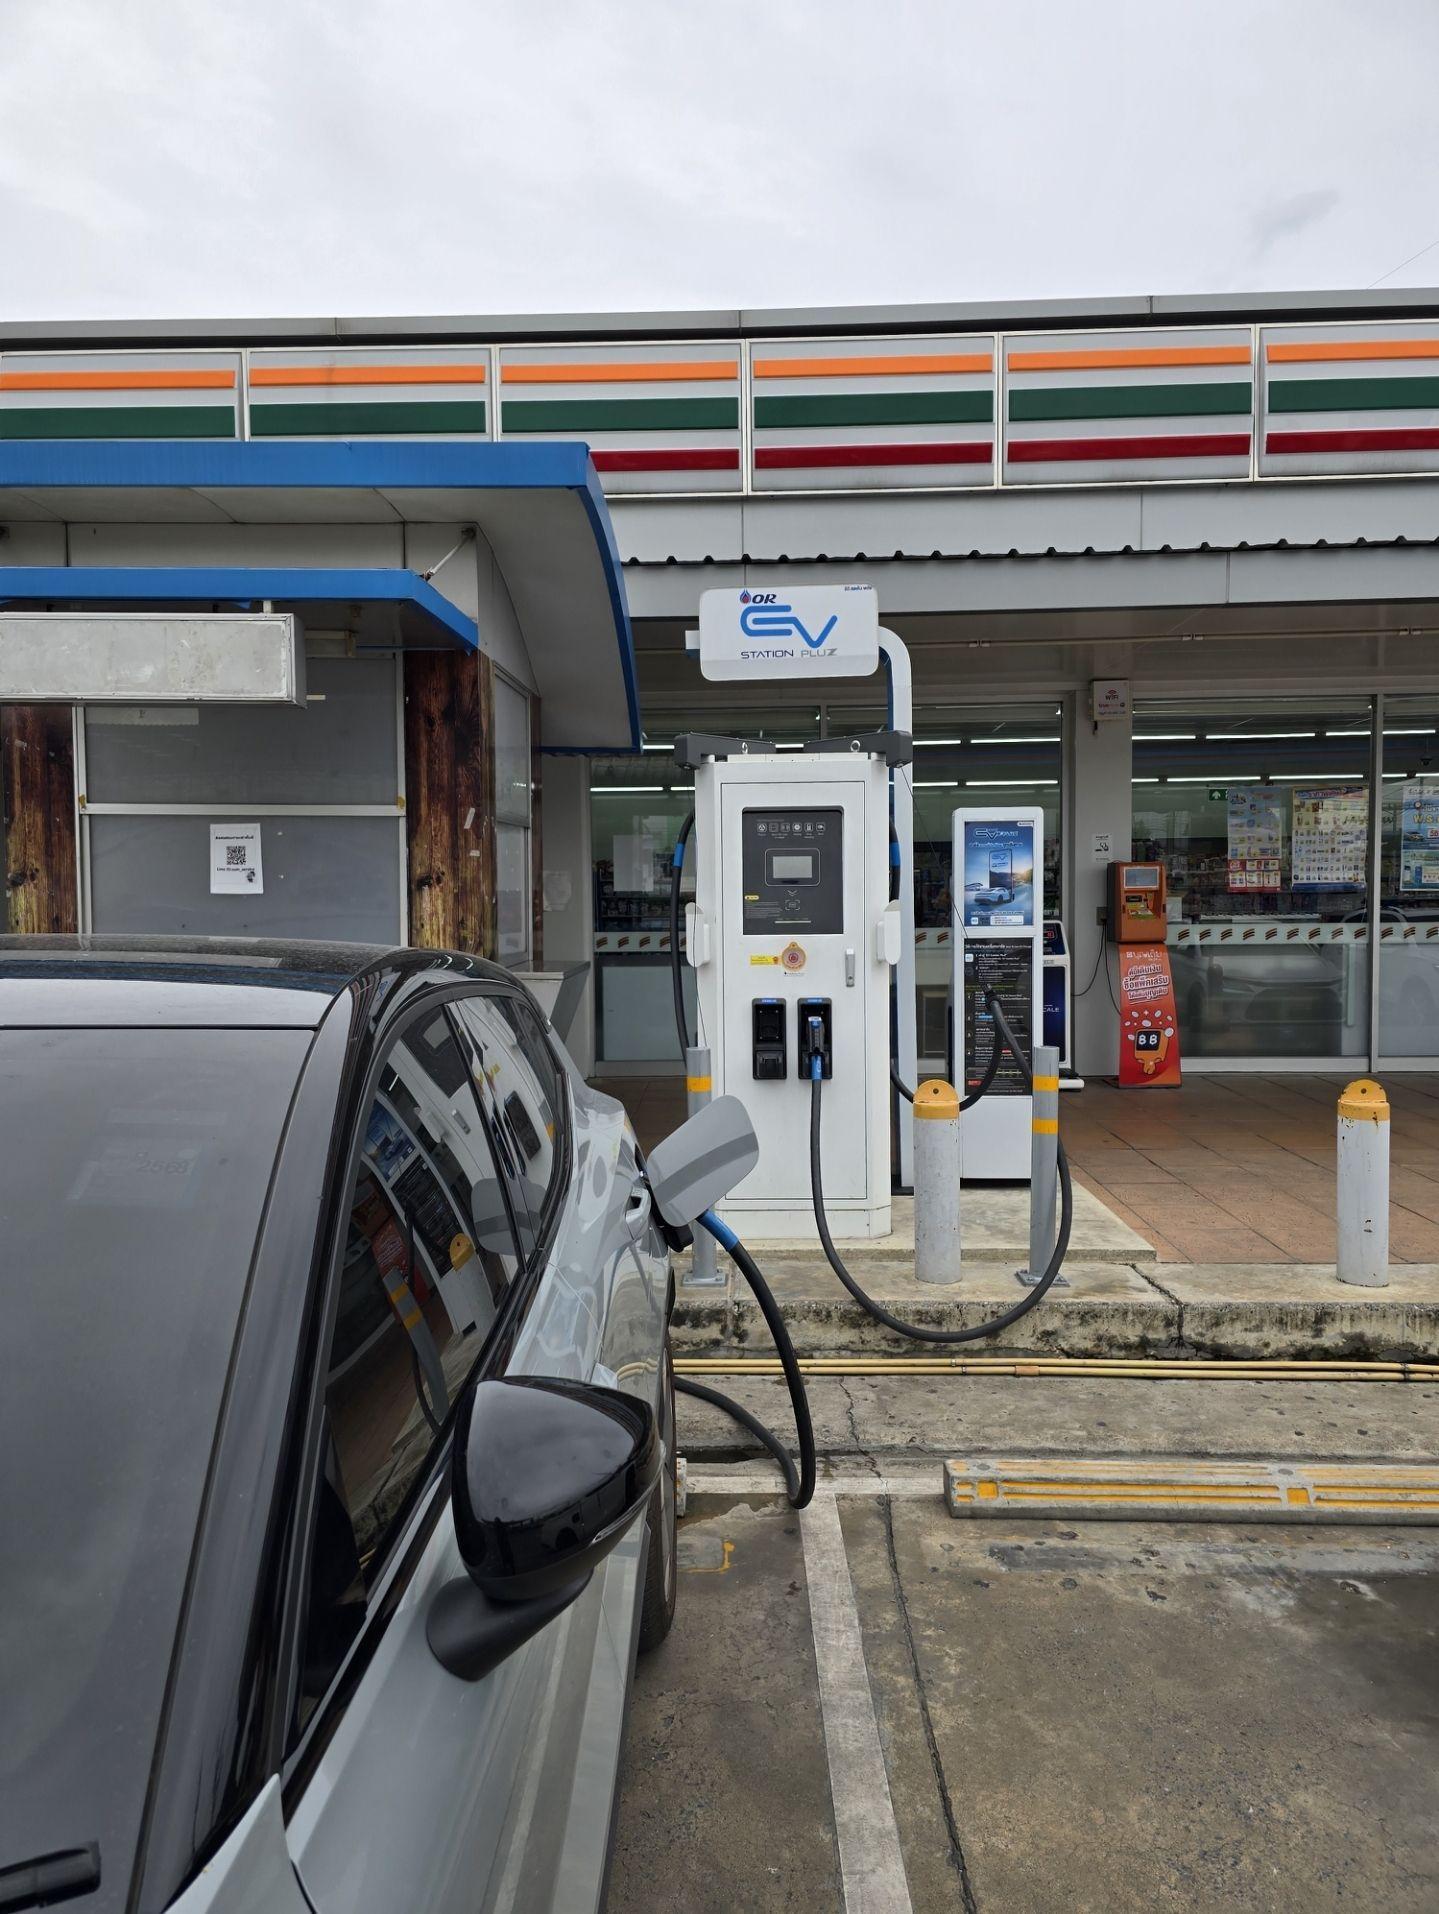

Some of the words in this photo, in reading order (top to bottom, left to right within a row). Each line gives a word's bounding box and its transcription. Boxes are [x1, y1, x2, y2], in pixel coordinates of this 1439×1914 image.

[752, 593, 777, 604] OR
[740, 605, 838, 649] EV
[741, 649, 794, 660] STATION
[801, 648, 838, 658] PLUZ
